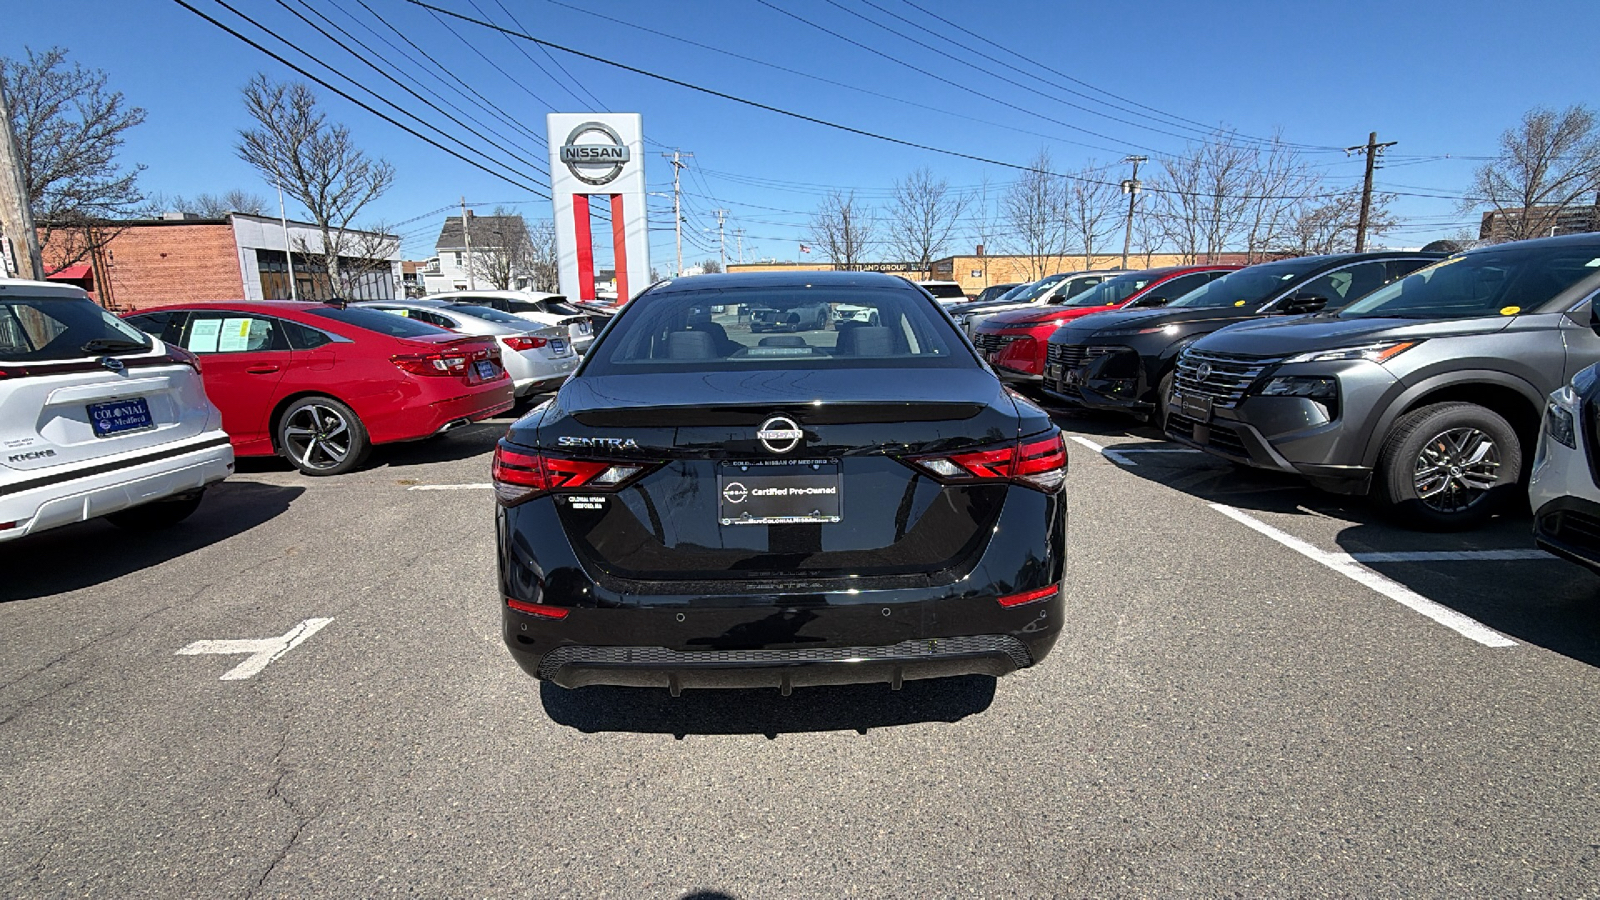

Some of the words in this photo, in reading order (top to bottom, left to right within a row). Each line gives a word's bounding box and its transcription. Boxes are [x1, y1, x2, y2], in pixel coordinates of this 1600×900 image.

[566, 147, 623, 158] NISSAN
[94, 405, 146, 420] COLONIAL
[114, 415, 146, 426] Medford
[757, 430, 803, 439] NISSAN
[558, 436, 639, 448] SENTRA
[8, 450, 58, 462] KICKS
[752, 488, 787, 496] Certified
[789, 487, 836, 495] Pre-Owned
